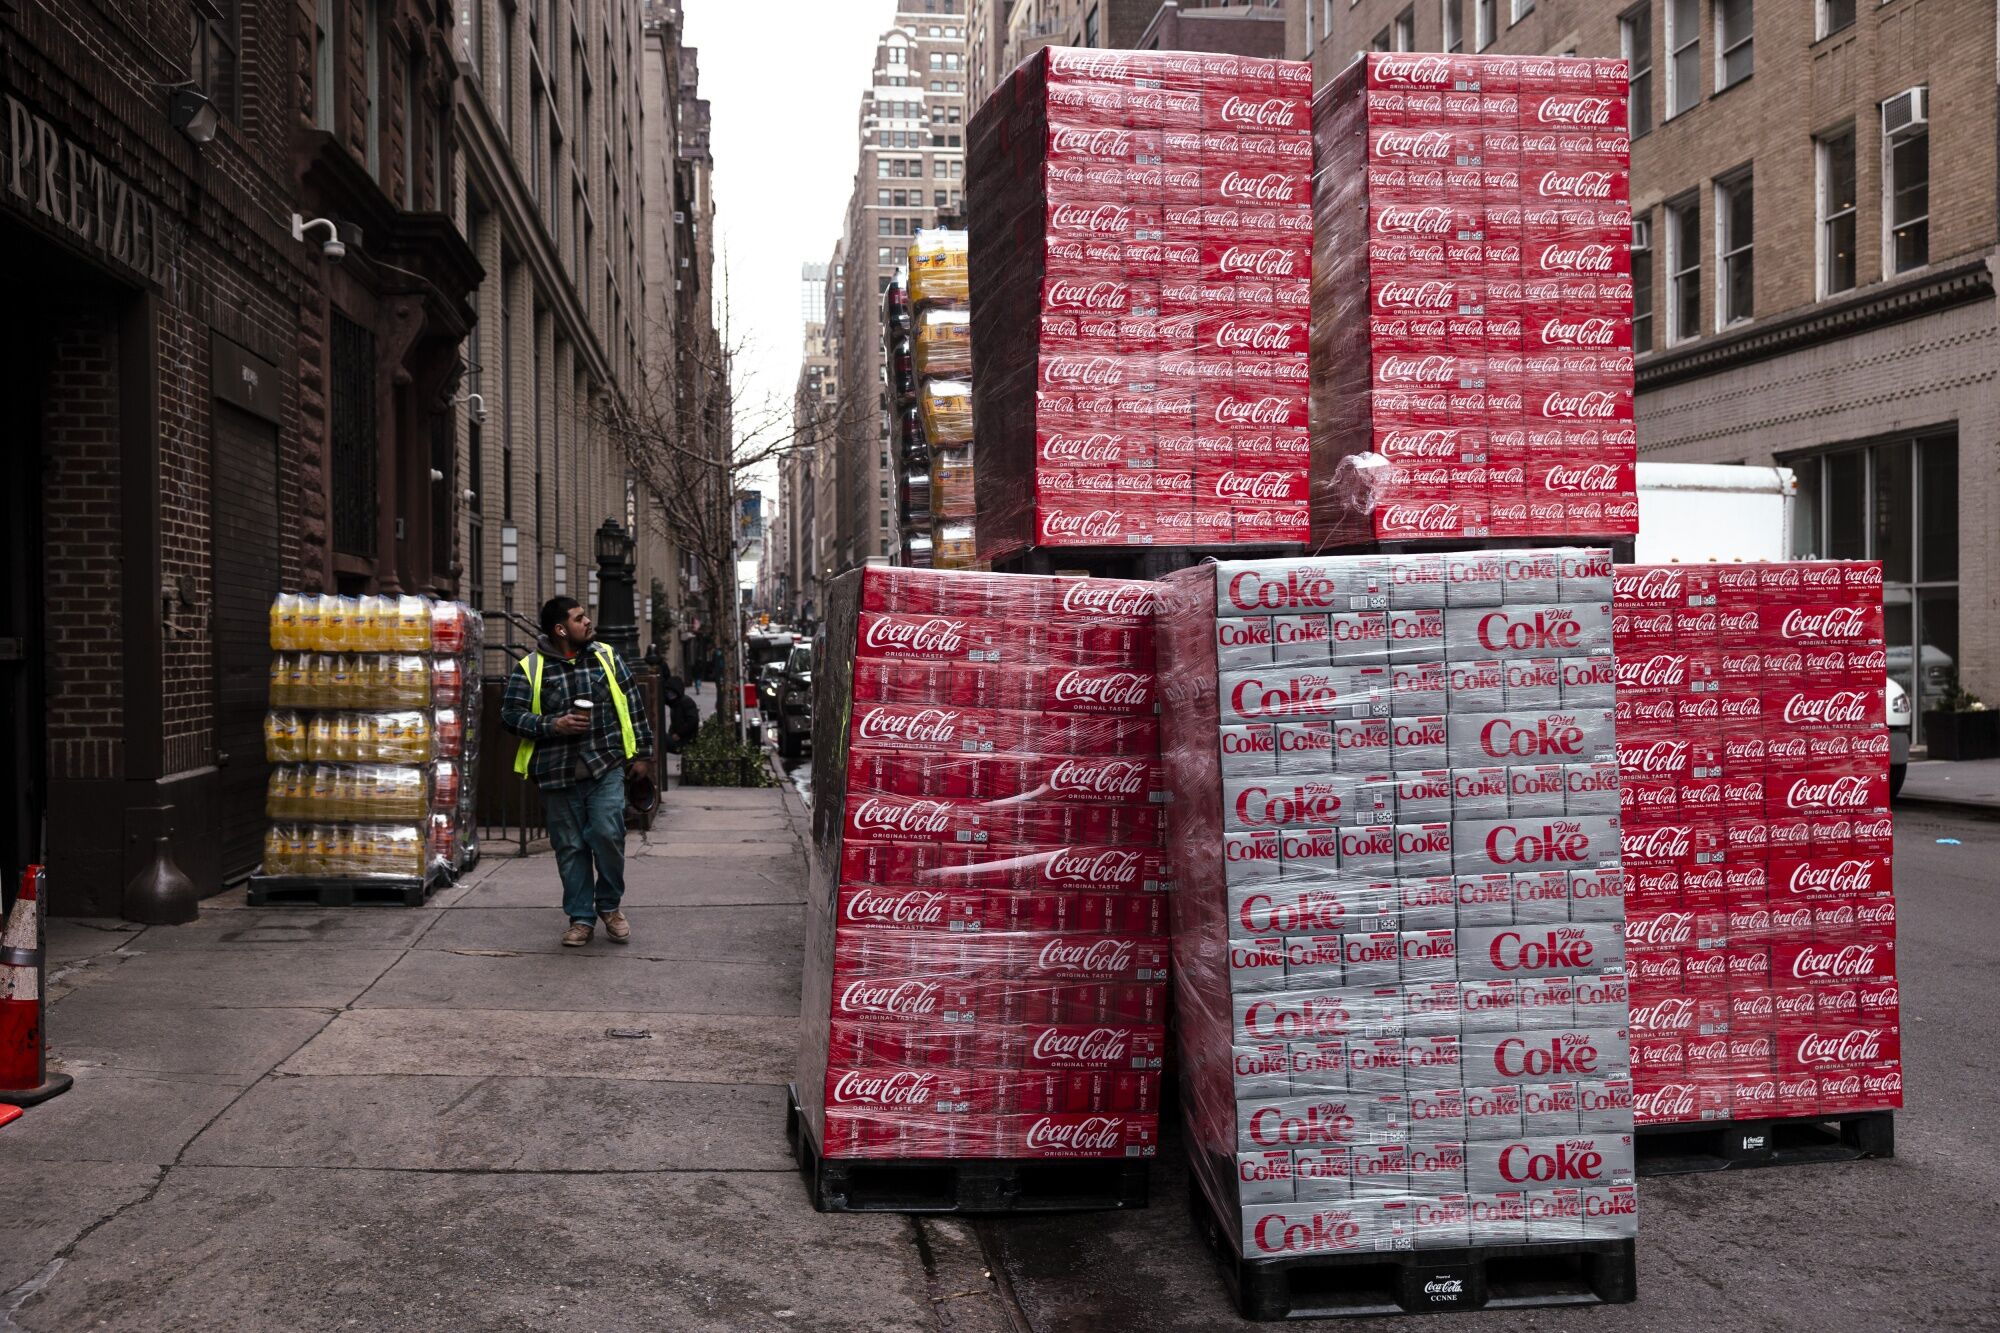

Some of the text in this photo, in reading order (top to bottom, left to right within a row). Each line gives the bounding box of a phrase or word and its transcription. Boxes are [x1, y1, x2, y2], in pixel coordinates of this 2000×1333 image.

[1052, 51, 1131, 78] Coca-Cola
[1375, 55, 1454, 83] Coca-Cola
[1222, 95, 1295, 126] Coca-Cola
[1538, 97, 1611, 124] Coca-Cola
[1053, 127, 1131, 155] Coca-Cola
[1376, 130, 1454, 157] Coca-Cola
[4, 92, 168, 287] PRETZEL
[1220, 171, 1295, 200] Coca-Cola
[1539, 170, 1613, 198] Coca-Cola
[1053, 203, 1131, 232] Coca-Cola
[1377, 206, 1453, 233] Coca-Cola
[1220, 246, 1295, 275] Coca-Cola
[1541, 244, 1614, 270] Coca-Cola
[1048, 280, 1128, 307] Coca-Cola
[1378, 280, 1456, 307] Coca-Cola
[1216, 321, 1292, 348] Coca-Cola
[1542, 318, 1616, 345] Coca-Cola
[1045, 356, 1123, 385] Coca-Cola
[1380, 355, 1456, 382] Coca-Cola
[1215, 396, 1292, 423] Coca-Cola
[1543, 391, 1618, 418] Coca-Cola
[1044, 433, 1123, 460] Coca-Cola
[1381, 430, 1458, 457] Coca-Cola
[1216, 471, 1292, 498] Coca-Cola
[1545, 464, 1619, 490] Coca-Cola
[1043, 509, 1123, 537] Coca-Cola
[1383, 503, 1458, 531] Coca-Cola
[1298, 566, 1326, 578] Diet
[1561, 558, 1611, 578] Coke
[1228, 571, 1335, 611] Coke
[1612, 568, 1687, 600] oca-Cola
[1064, 582, 1153, 616] Coca-Cola
[1545, 608, 1573, 621] Diet
[1782, 607, 1867, 639] Coca-Cola
[866, 616, 968, 651] Coca-Cola
[1219, 625, 1270, 645] Coke
[1477, 611, 1582, 651] Coke
[1300, 675, 1329, 687] Diet
[1564, 665, 1614, 685] Coke
[1615, 654, 1690, 685] oca-Cola
[1056, 670, 1153, 704] Coca-Cola
[1231, 679, 1337, 719] Coke
[1548, 714, 1575, 727] Diet
[1784, 691, 1869, 723] Coca-Cola
[859, 708, 960, 741] Coca-Cola
[1480, 719, 1584, 757] Coke
[1223, 733, 1273, 753] Coke
[1616, 740, 1692, 771] oca-Cola
[1051, 760, 1149, 793] Coca-Cola
[1306, 782, 1332, 794] Diet
[1235, 786, 1342, 827] Coke
[1788, 776, 1872, 808] Coca-Cola
[854, 798, 956, 832] Coca-Cola
[1553, 821, 1580, 833] Diet
[1399, 832, 1449, 853] Coke
[1485, 826, 1590, 864] Coke
[1620, 825, 1696, 858] oca-Cola
[1045, 847, 1143, 883] Coca-Cola
[1790, 860, 1875, 892] Coca-Cola
[847, 889, 947, 922] Coca-Cola
[1310, 890, 1337, 901] Diet
[1240, 894, 1346, 934] Coke
[1624, 912, 1696, 945] ca-Cola
[1558, 928, 1584, 940] Diet
[1039, 938, 1136, 971] Coca-Cola
[1489, 932, 1594, 971] Coke
[1793, 944, 1878, 979] Coca-Cola
[841, 980, 942, 1012] Coca-Cola
[1314, 996, 1341, 1008] Diet
[1245, 1001, 1350, 1039] Coke
[1629, 998, 1698, 1030] ca-Cola
[1033, 1027, 1131, 1060] Coca-Cola
[1561, 1034, 1589, 1046] Diet
[1798, 1029, 1883, 1064] Coca-Cola
[1494, 1039, 1598, 1078] Coke
[834, 1071, 935, 1103] Coca-Cola
[1633, 1083, 1698, 1116] ca-Cola
[1319, 1103, 1347, 1115] Diet
[1026, 1117, 1125, 1150] Coca-Cola
[1249, 1107, 1354, 1146] Coke
[1566, 1140, 1595, 1152] Diet
[1240, 1160, 1292, 1181] Coke
[1498, 1144, 1602, 1184] Coke
[1324, 1209, 1353, 1221] Diet
[1586, 1196, 1636, 1216] Coke
[1254, 1214, 1359, 1252] Coke
[1424, 1280, 1462, 1294] Coca-Cola
